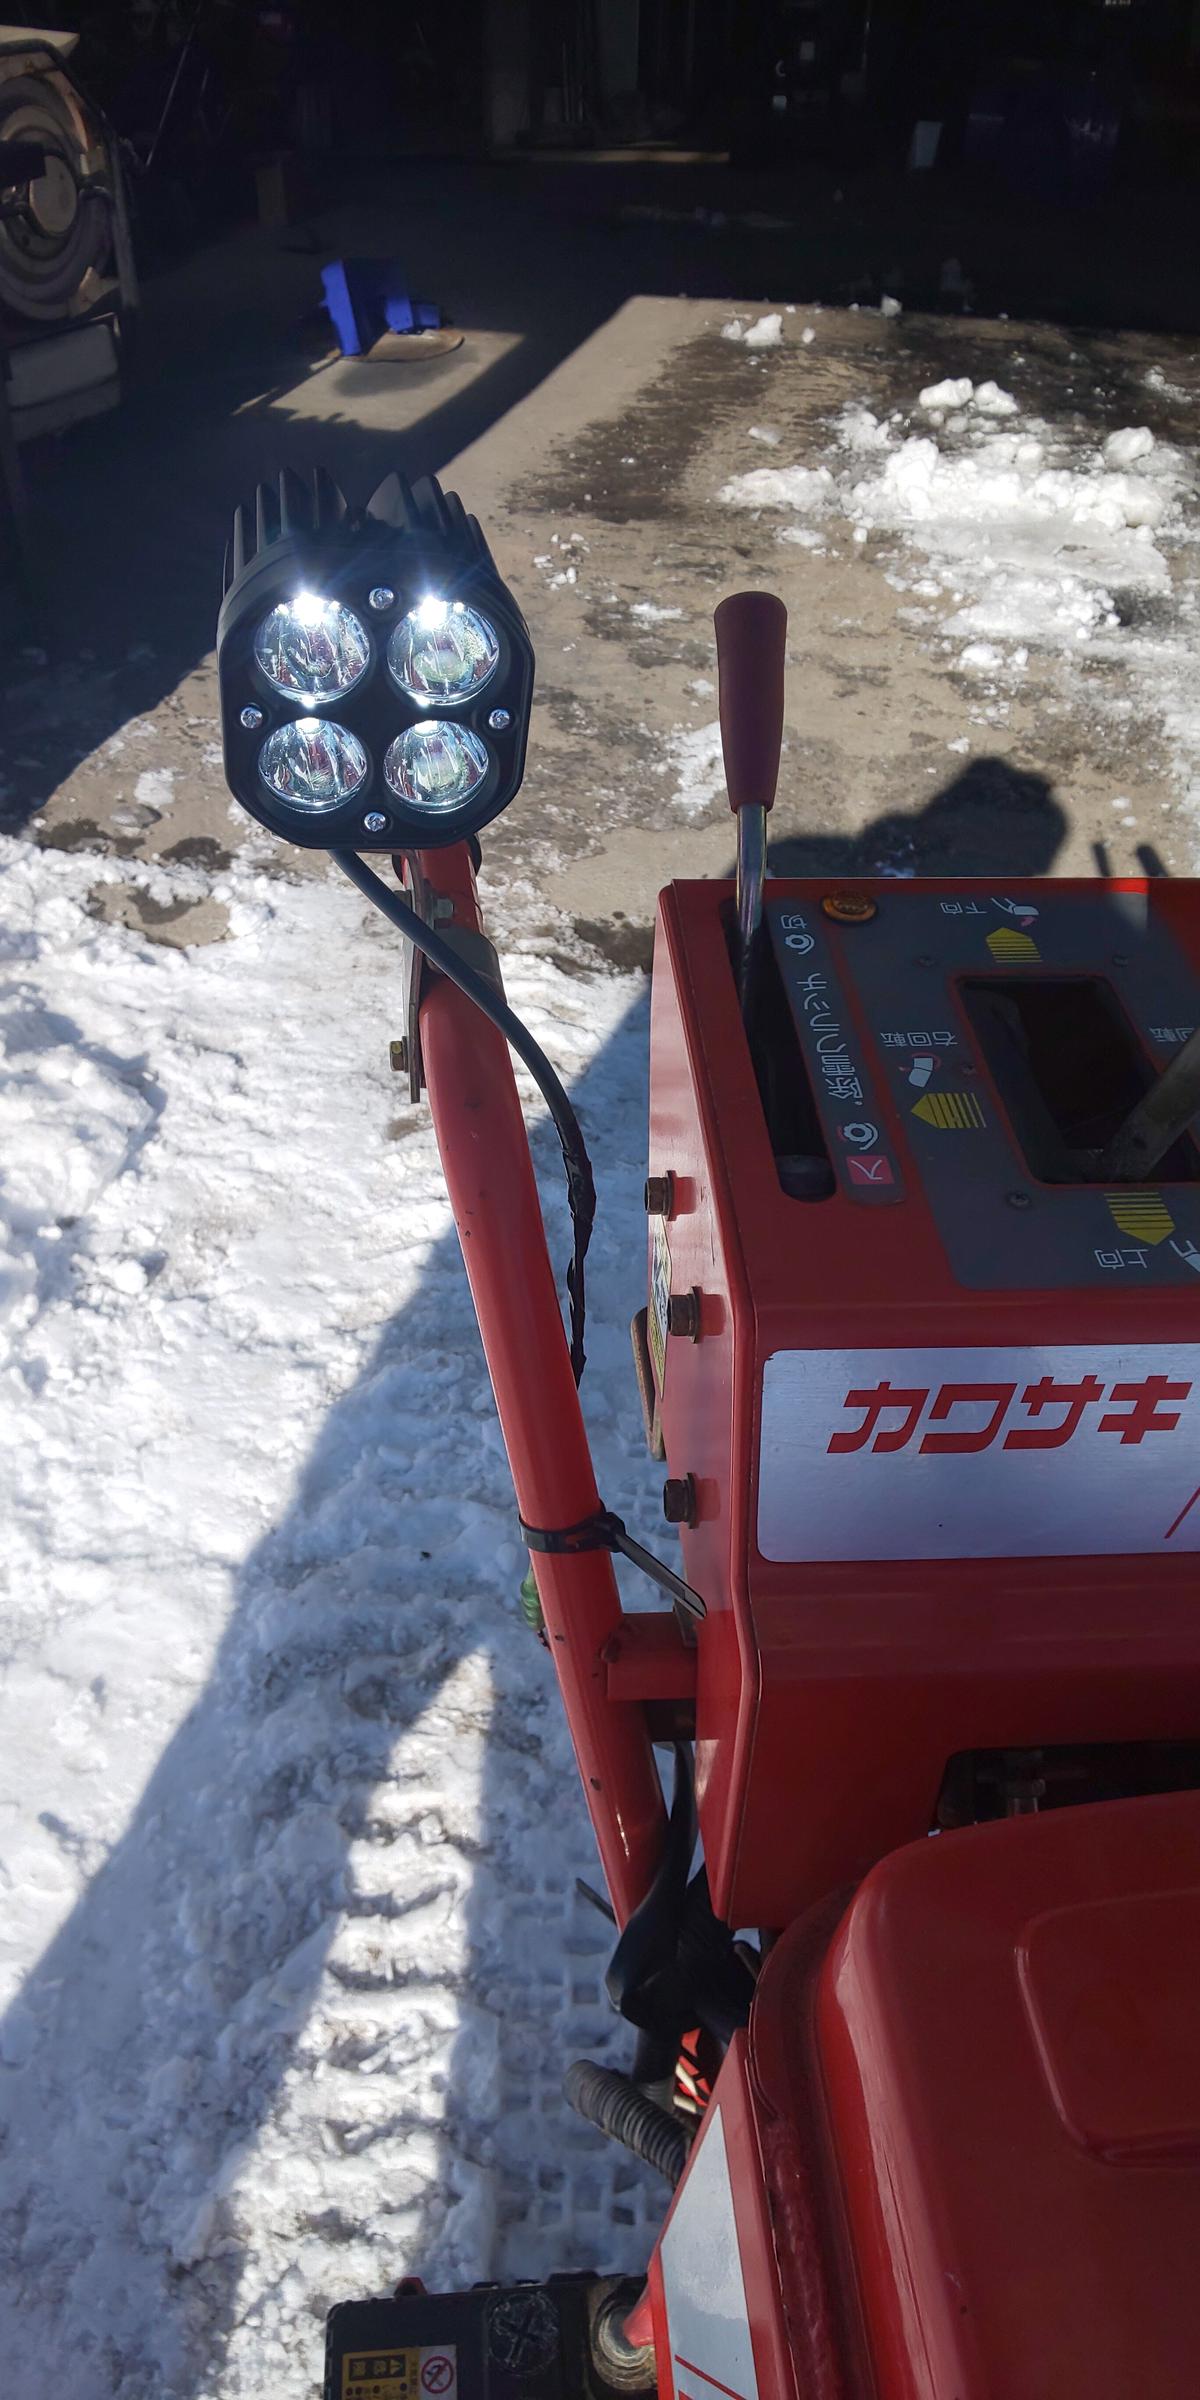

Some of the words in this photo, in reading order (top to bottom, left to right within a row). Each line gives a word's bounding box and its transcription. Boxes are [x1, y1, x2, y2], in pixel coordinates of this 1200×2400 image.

[940, 901, 988, 915] 下向
[780, 914, 808, 929] 切
[796, 972, 864, 1099] 除雪クラッチ
[879, 1031, 959, 1047] 右回転
[1149, 1027, 1195, 1042] 回転
[850, 1159, 883, 1181] 入
[1094, 1249, 1149, 1270] 上向
[826, 1374, 1193, 1454] カワサキ
